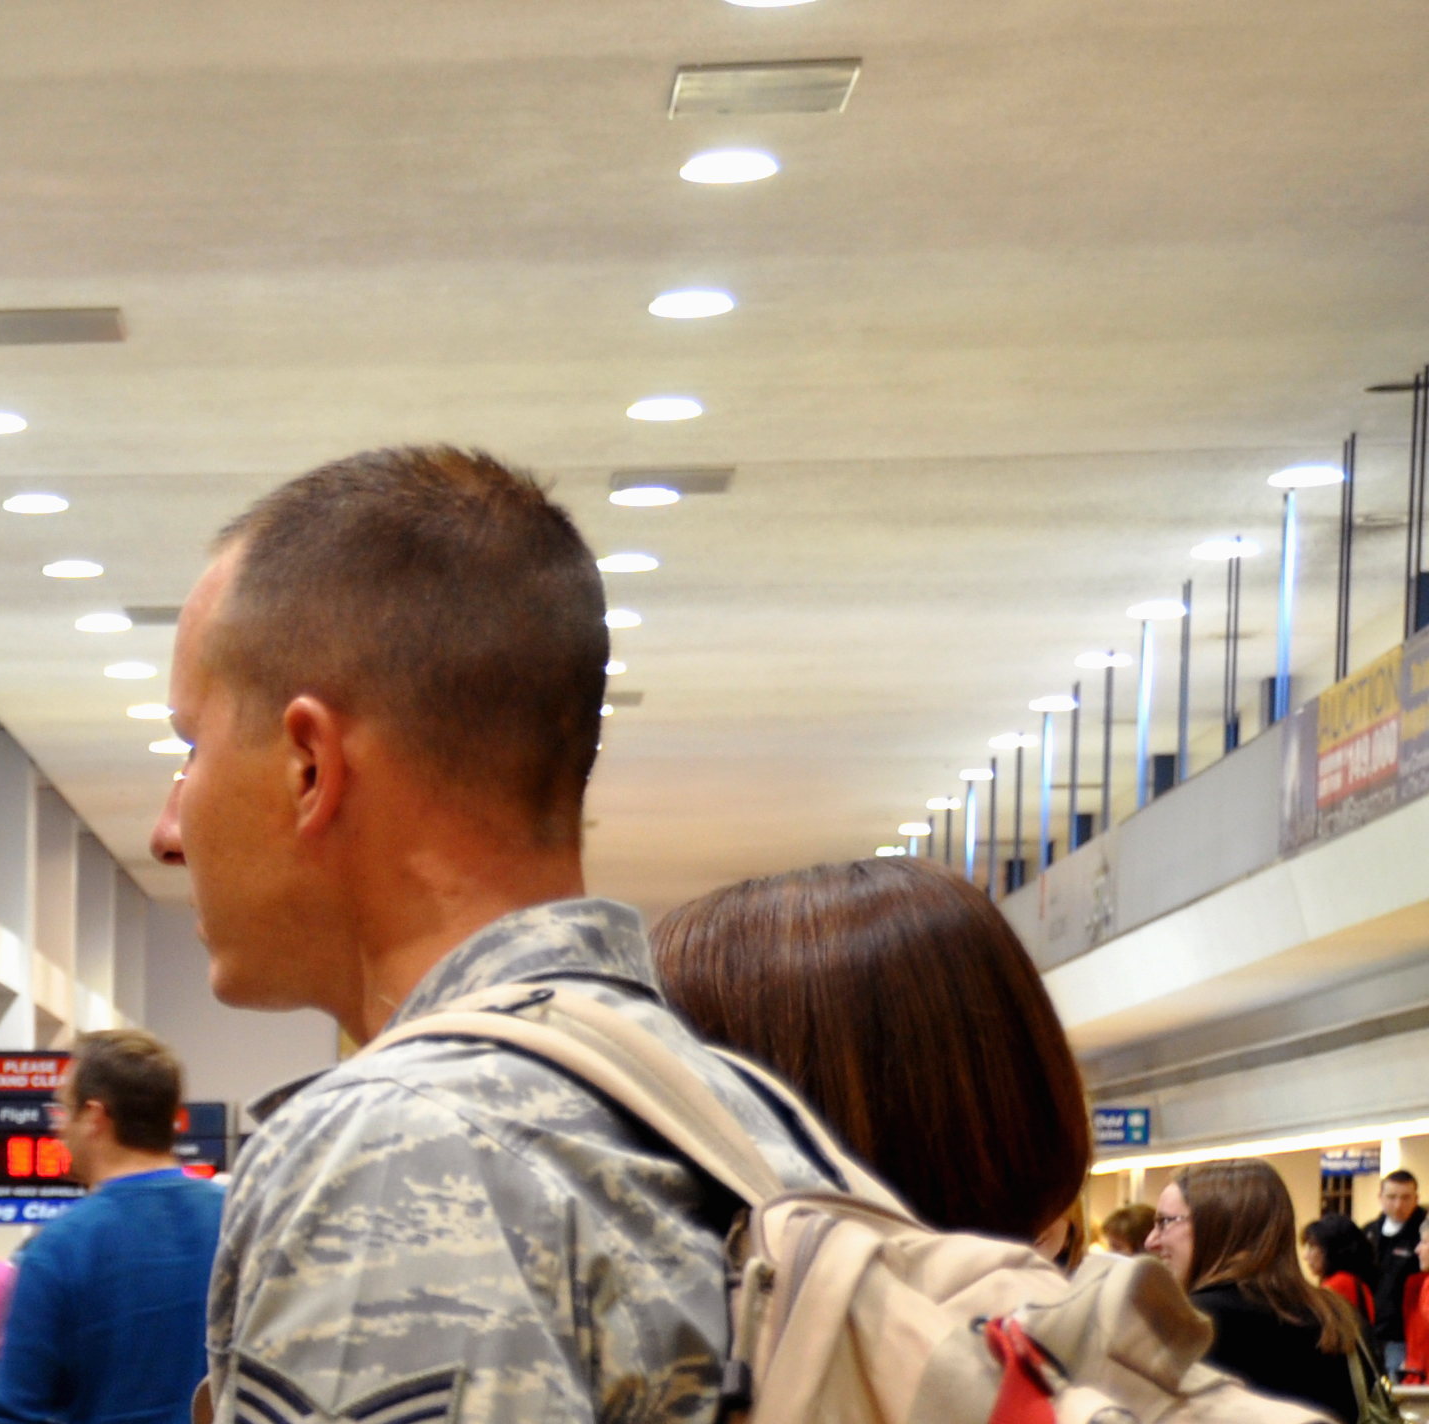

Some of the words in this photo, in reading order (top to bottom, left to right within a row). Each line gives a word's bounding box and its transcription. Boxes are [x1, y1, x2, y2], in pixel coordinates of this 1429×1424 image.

[3, 1060, 58, 1074] PLEASE
[30, 1074, 68, 1088] CLEA
[0, 1107, 39, 1125] Flight
